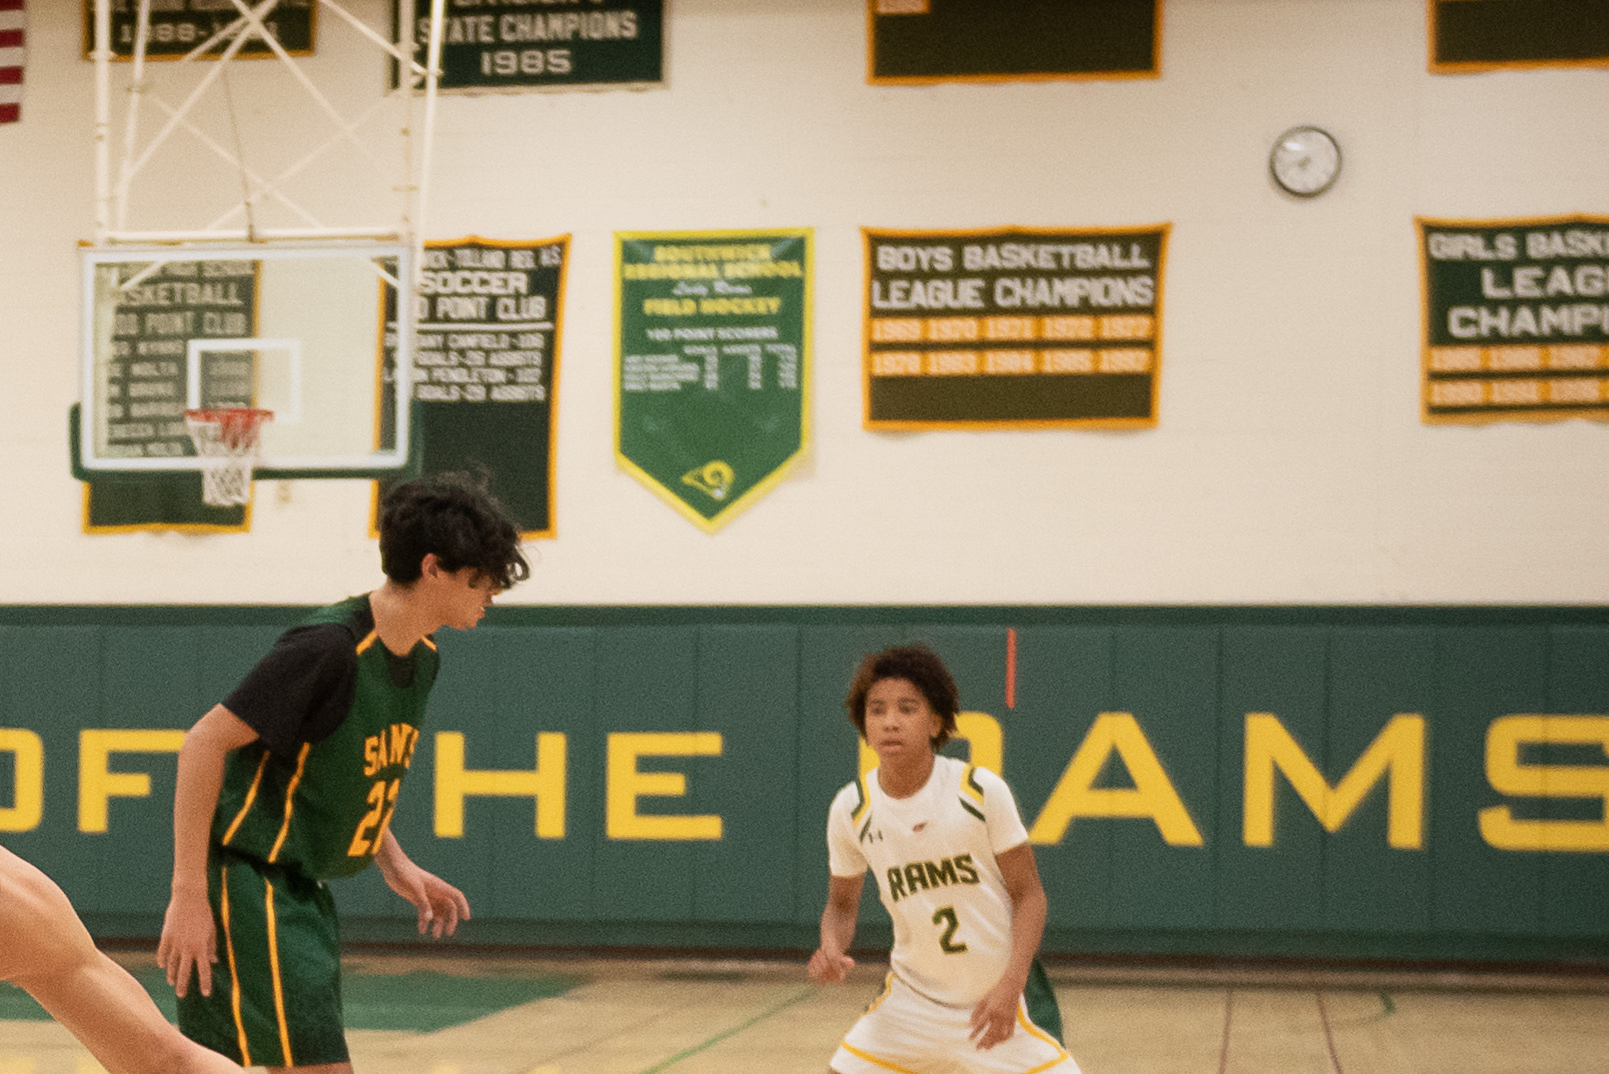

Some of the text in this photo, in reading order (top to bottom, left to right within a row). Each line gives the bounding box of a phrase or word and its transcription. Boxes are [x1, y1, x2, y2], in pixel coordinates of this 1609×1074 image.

[499, 10, 638, 41] CHAMPIONS
[480, 49, 572, 76] 1985
[877, 243, 1151, 271] BOYS BASKETBALL
[1526, 230, 1609, 259] BASK
[419, 271, 528, 295] SOCCER
[872, 276, 1154, 309] LEAGUE CHAMPIONS
[433, 730, 724, 841] HE
[886, 852, 980, 902] RAMS
[931, 905, 968, 954] 2
